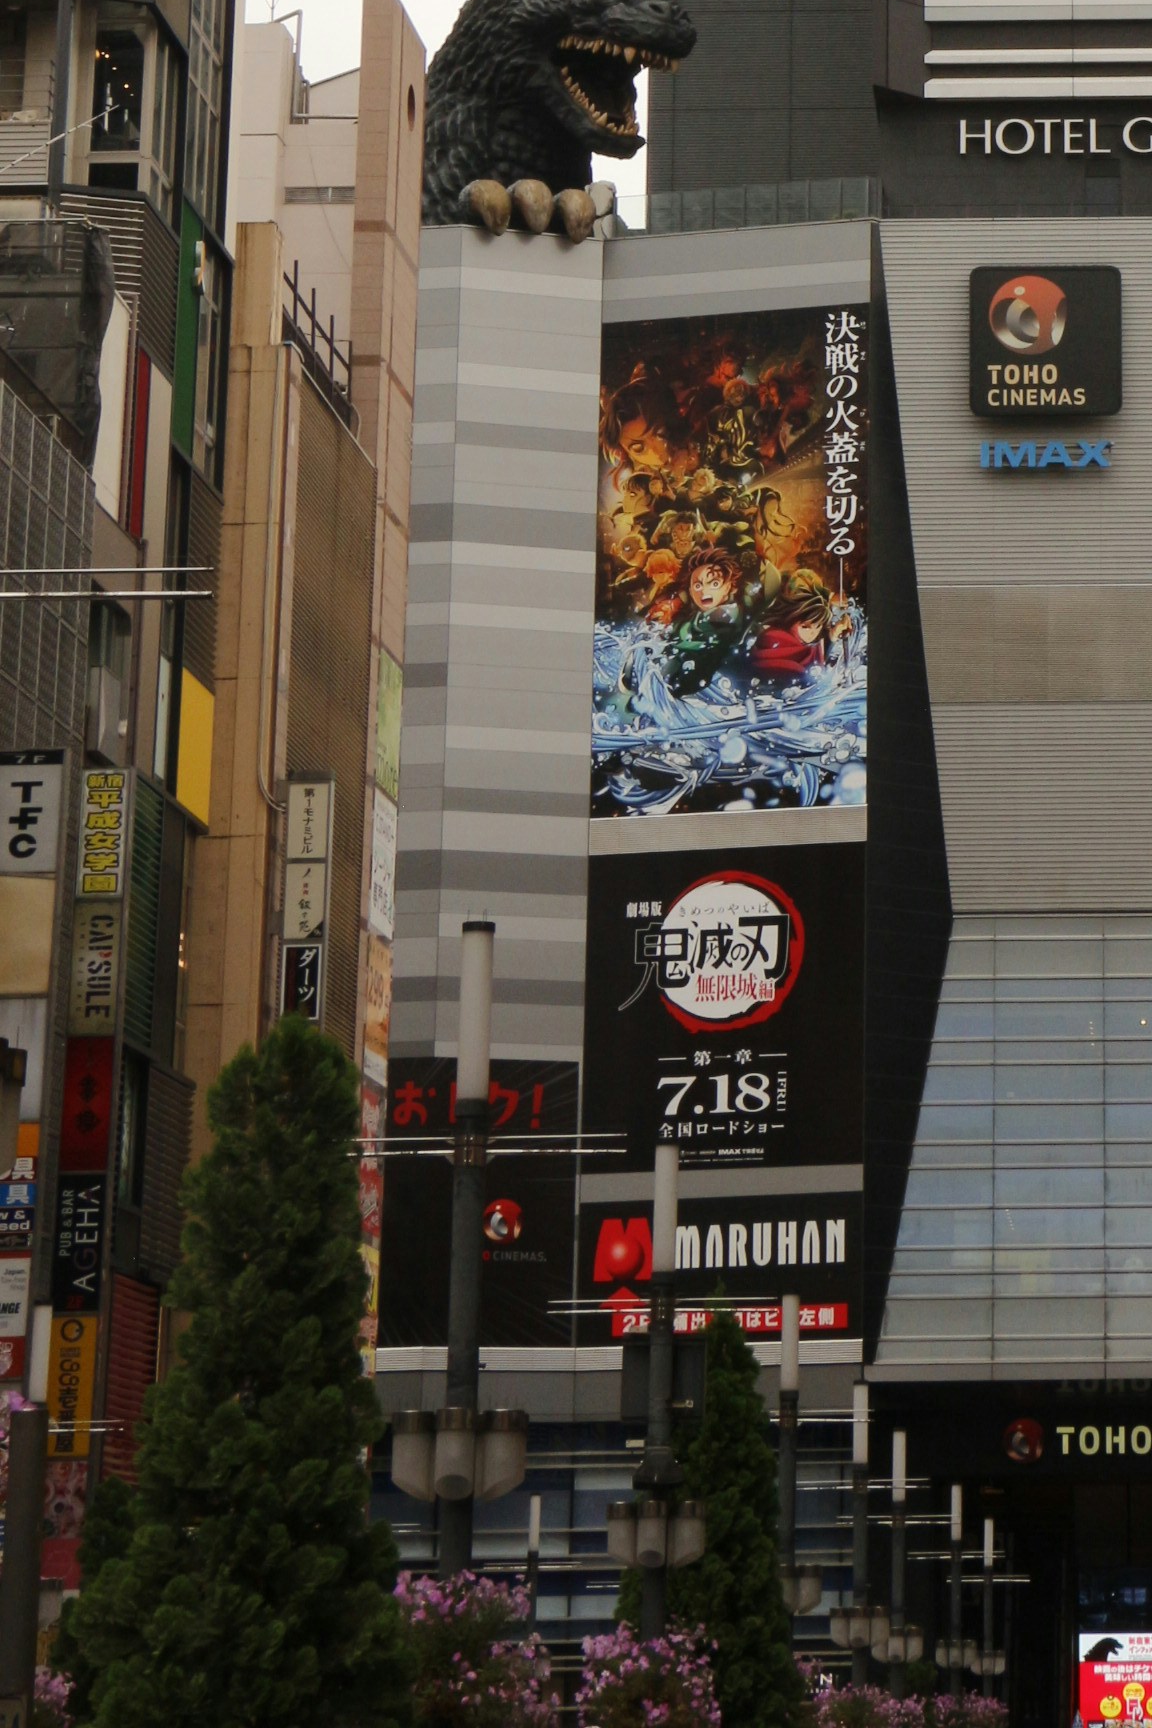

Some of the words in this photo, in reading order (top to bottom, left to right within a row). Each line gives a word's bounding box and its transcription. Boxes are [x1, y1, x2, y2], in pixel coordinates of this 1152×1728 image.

[959, 118, 1111, 154] HOTEL
[987, 364, 1058, 385] TOHO
[987, 388, 1086, 407] CINEMAS
[980, 440, 1112, 469] IMAX
[626, 901, 662, 918] 劇場版
[85, 914, 114, 1019] CAPSULE
[298, 948, 318, 1002] ダーツ
[618, 913, 790, 1011] 鬼滅の刃
[694, 973, 776, 1003] 無限城編
[657, 1072, 771, 1117] 7.18
[658, 1121, 786, 1139] 全国ロードショー
[62, 1189, 75, 1215] BAR
[59, 1231, 73, 1257] PUB
[72, 1184, 101, 1293] AGEHA
[675, 1218, 846, 1270] MARUHAN
[1057, 1425, 1151, 1455] TOHO
